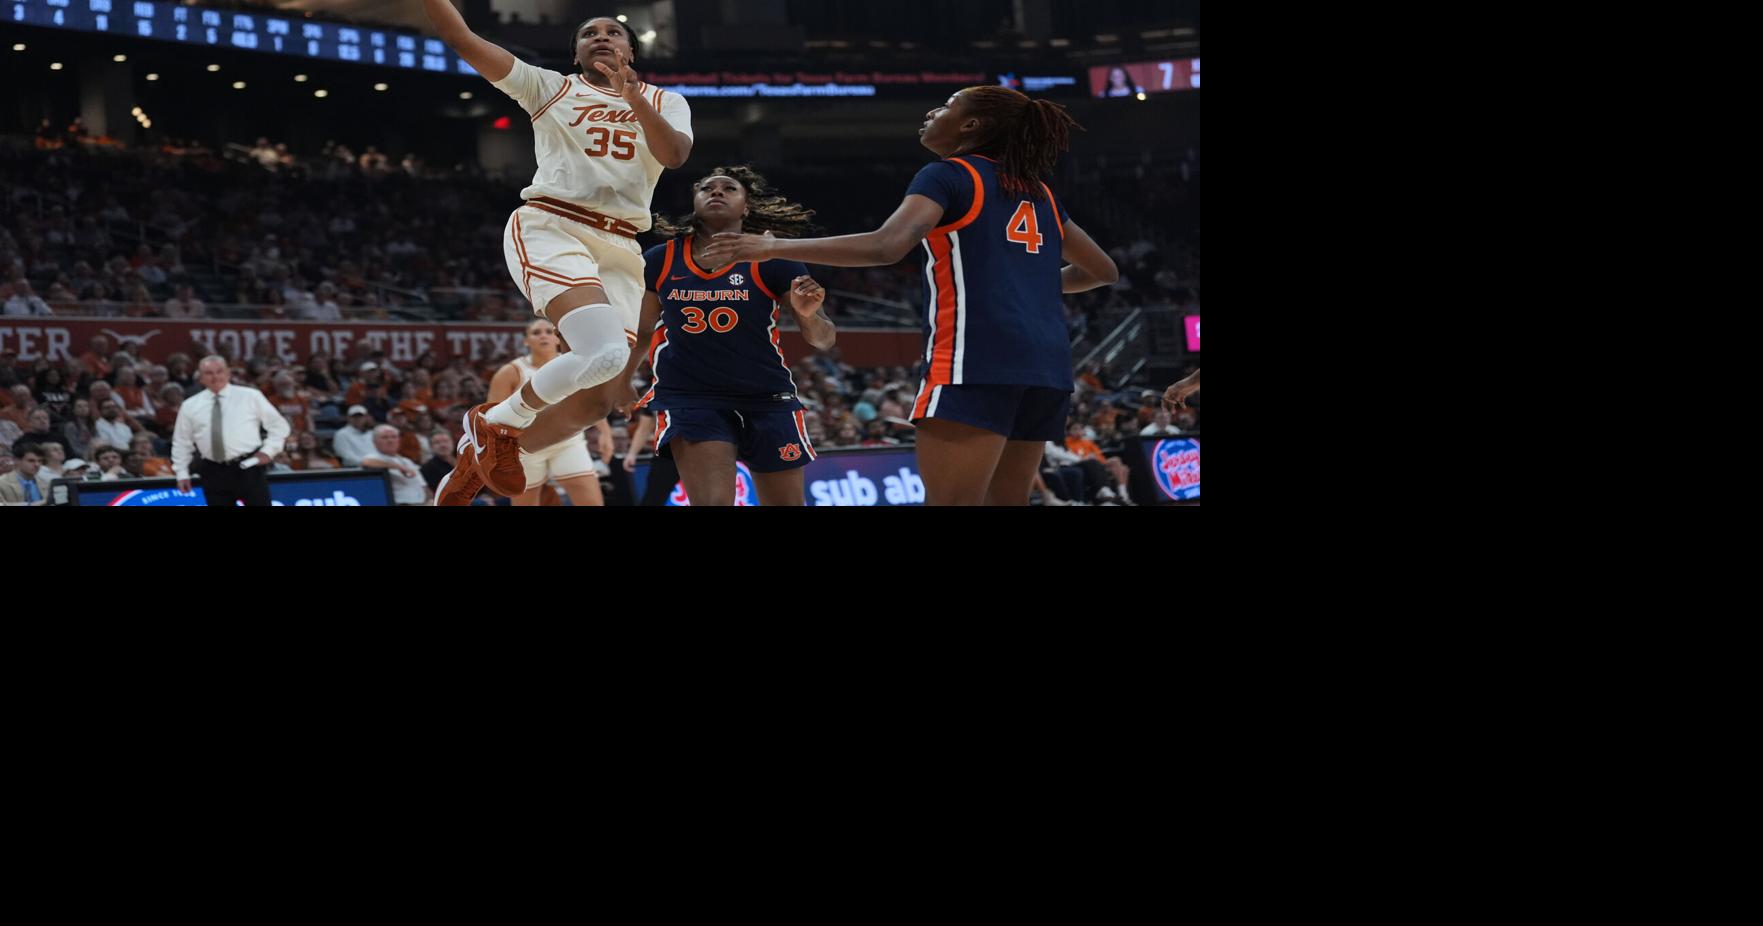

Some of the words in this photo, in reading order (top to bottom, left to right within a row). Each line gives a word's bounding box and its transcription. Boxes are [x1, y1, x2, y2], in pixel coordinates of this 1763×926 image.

[1158, 62, 1173, 90] 7
[568, 104, 640, 127] Texa
[584, 126, 637, 161] 35
[1006, 200, 1043, 254] 4
[728, 273, 744, 286] SEC
[667, 288, 749, 301] AUBURN
[680, 306, 739, 334] 30
[310, 330, 353, 361] OF
[365, 331, 434, 361] THE
[810, 470, 878, 506] sub
